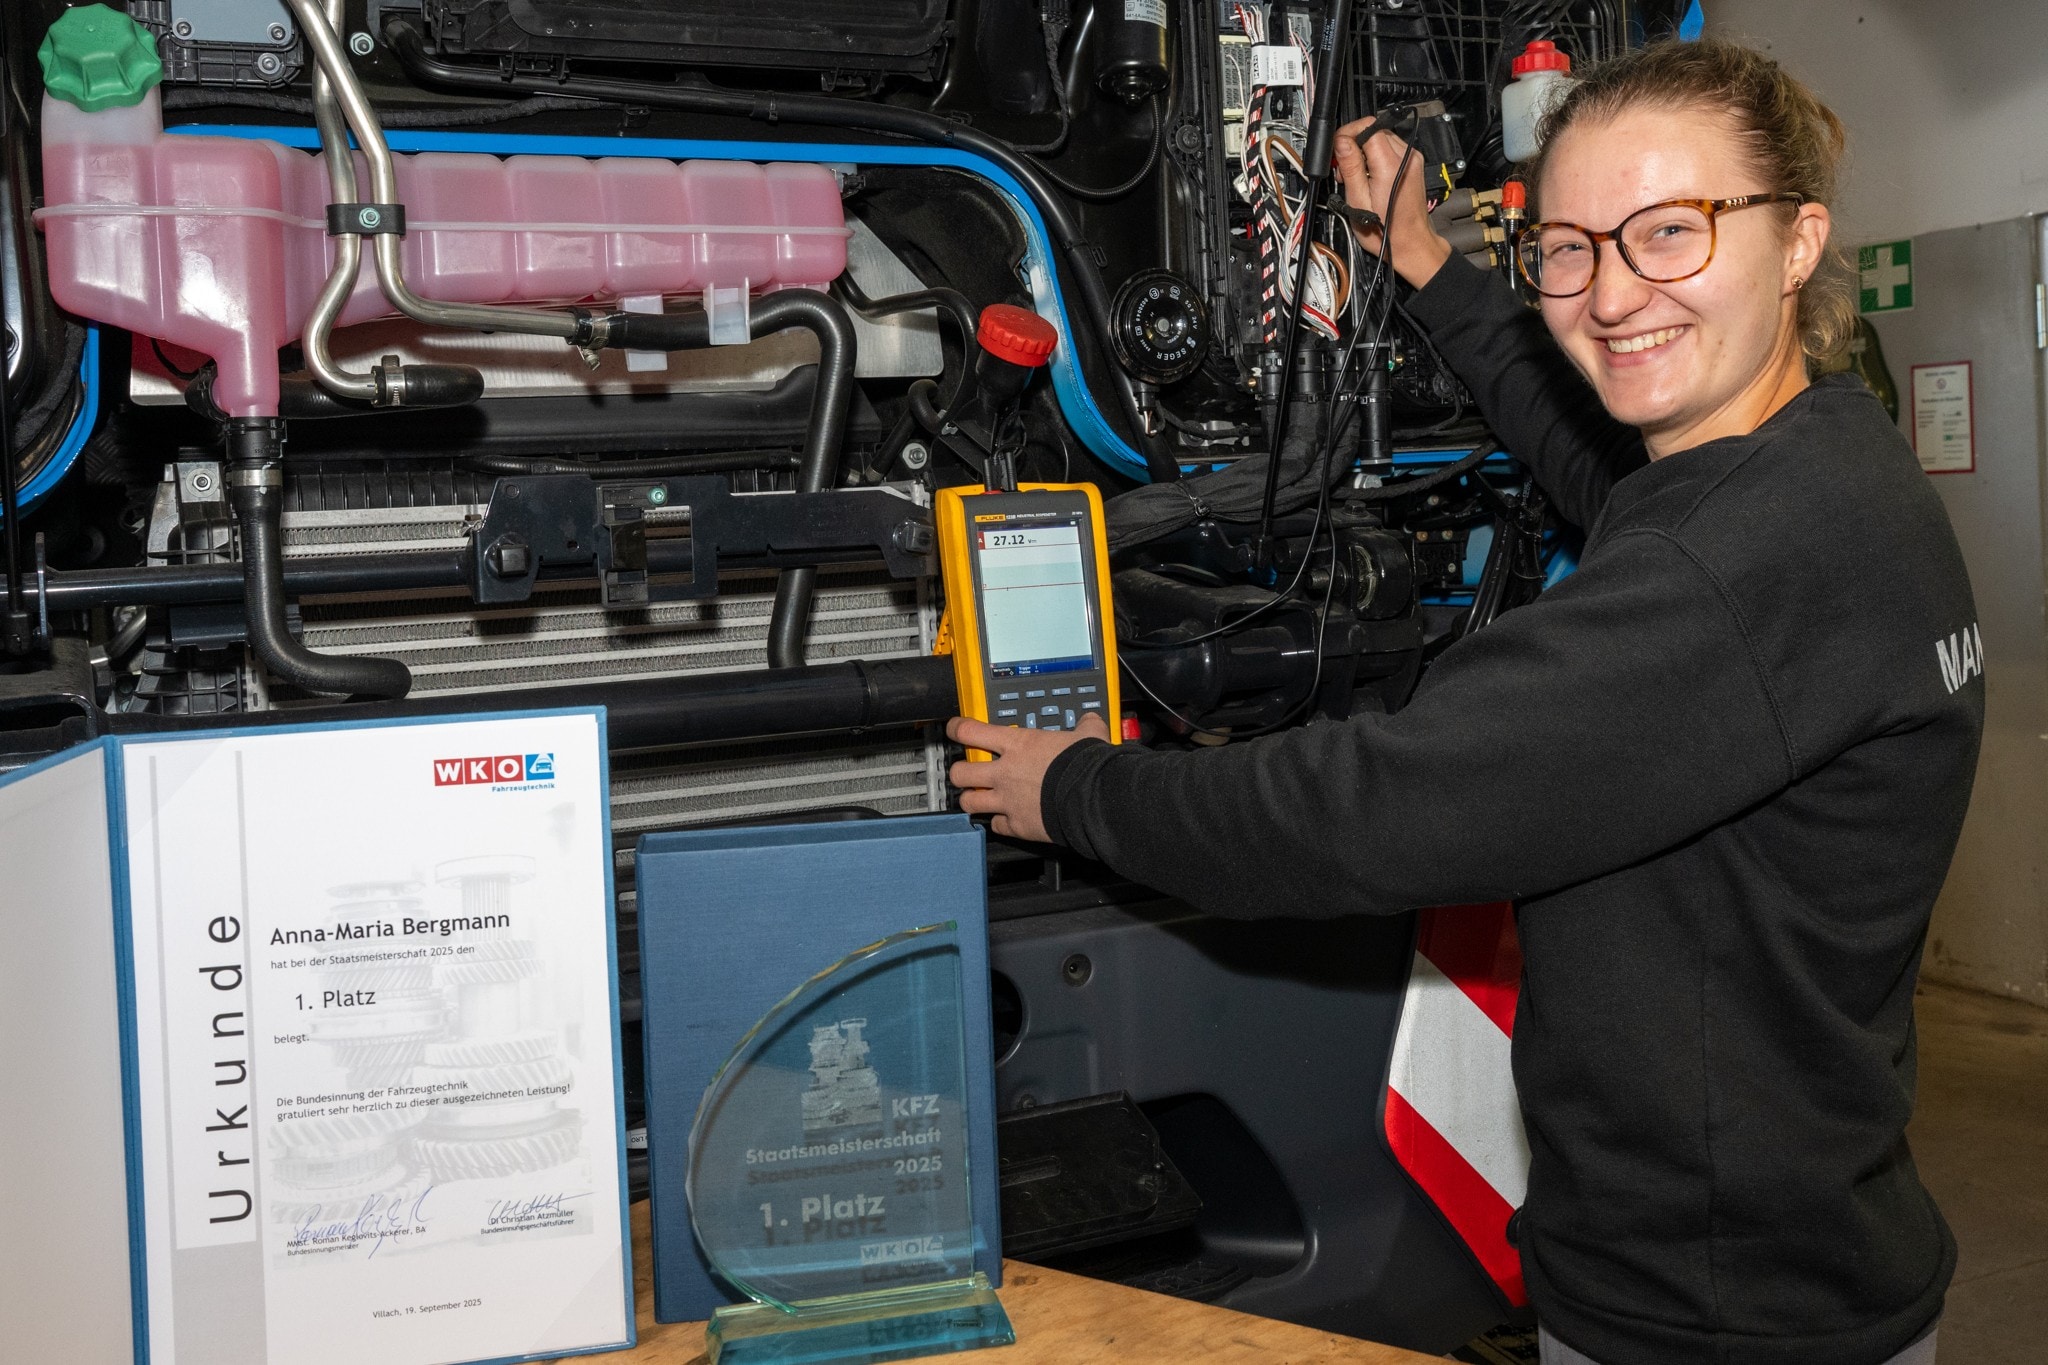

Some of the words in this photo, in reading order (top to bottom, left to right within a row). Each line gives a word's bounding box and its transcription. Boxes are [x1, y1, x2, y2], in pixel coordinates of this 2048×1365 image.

[1156, 347, 1187, 361] SEGER
[993, 534, 1025, 546] 27.12
[435, 758, 520, 782] WKO
[491, 783, 555, 792] Fahrzeugtechnik
[270, 920, 395, 946] Anna-Maria
[402, 914, 510, 937] Bergmann
[270, 960, 287, 969] hat
[290, 958, 306, 968] bei
[309, 956, 327, 967] der
[329, 948, 427, 965] Staatsmeisterschaft
[430, 946, 454, 957] 2025
[456, 945, 475, 955] den
[295, 994, 313, 1011] 1.
[323, 990, 376, 1009] Platz
[273, 1033, 310, 1044] belegt.
[198, 915, 253, 1225] Urkunde
[276, 1097, 294, 1107] Die
[296, 1091, 365, 1105] Bundesinnung
[367, 1089, 384, 1098] der
[387, 1081, 468, 1096] Fahrzeugtechnik
[277, 1108, 326, 1122] gratuliert
[328, 1106, 350, 1116] sehr
[352, 1101, 393, 1112] herzlich
[395, 1101, 407, 1109] zu
[409, 1096, 440, 1108] dieser
[442, 1089, 524, 1104] ausgezeichneten
[526, 1083, 571, 1096] Leistung!
[891, 1094, 941, 1118] KFZ
[746, 1127, 941, 1165] Staatsmeisterschaft
[893, 1155, 943, 1175] 2025
[500, 1213, 535, 1224] Christian
[537, 1209, 574, 1220] Atzmüller
[759, 1201, 788, 1228] 1.
[801, 1194, 886, 1223] Platz
[312, 1236, 340, 1245] Roman
[415, 1226, 427, 1234] BA
[287, 1242, 359, 1256] Bundesinnungsmeister
[372, 1308, 402, 1319] Villach,
[405, 1306, 417, 1314] 19.
[419, 1302, 461, 1314] September
[463, 1298, 482, 1308] 2025
